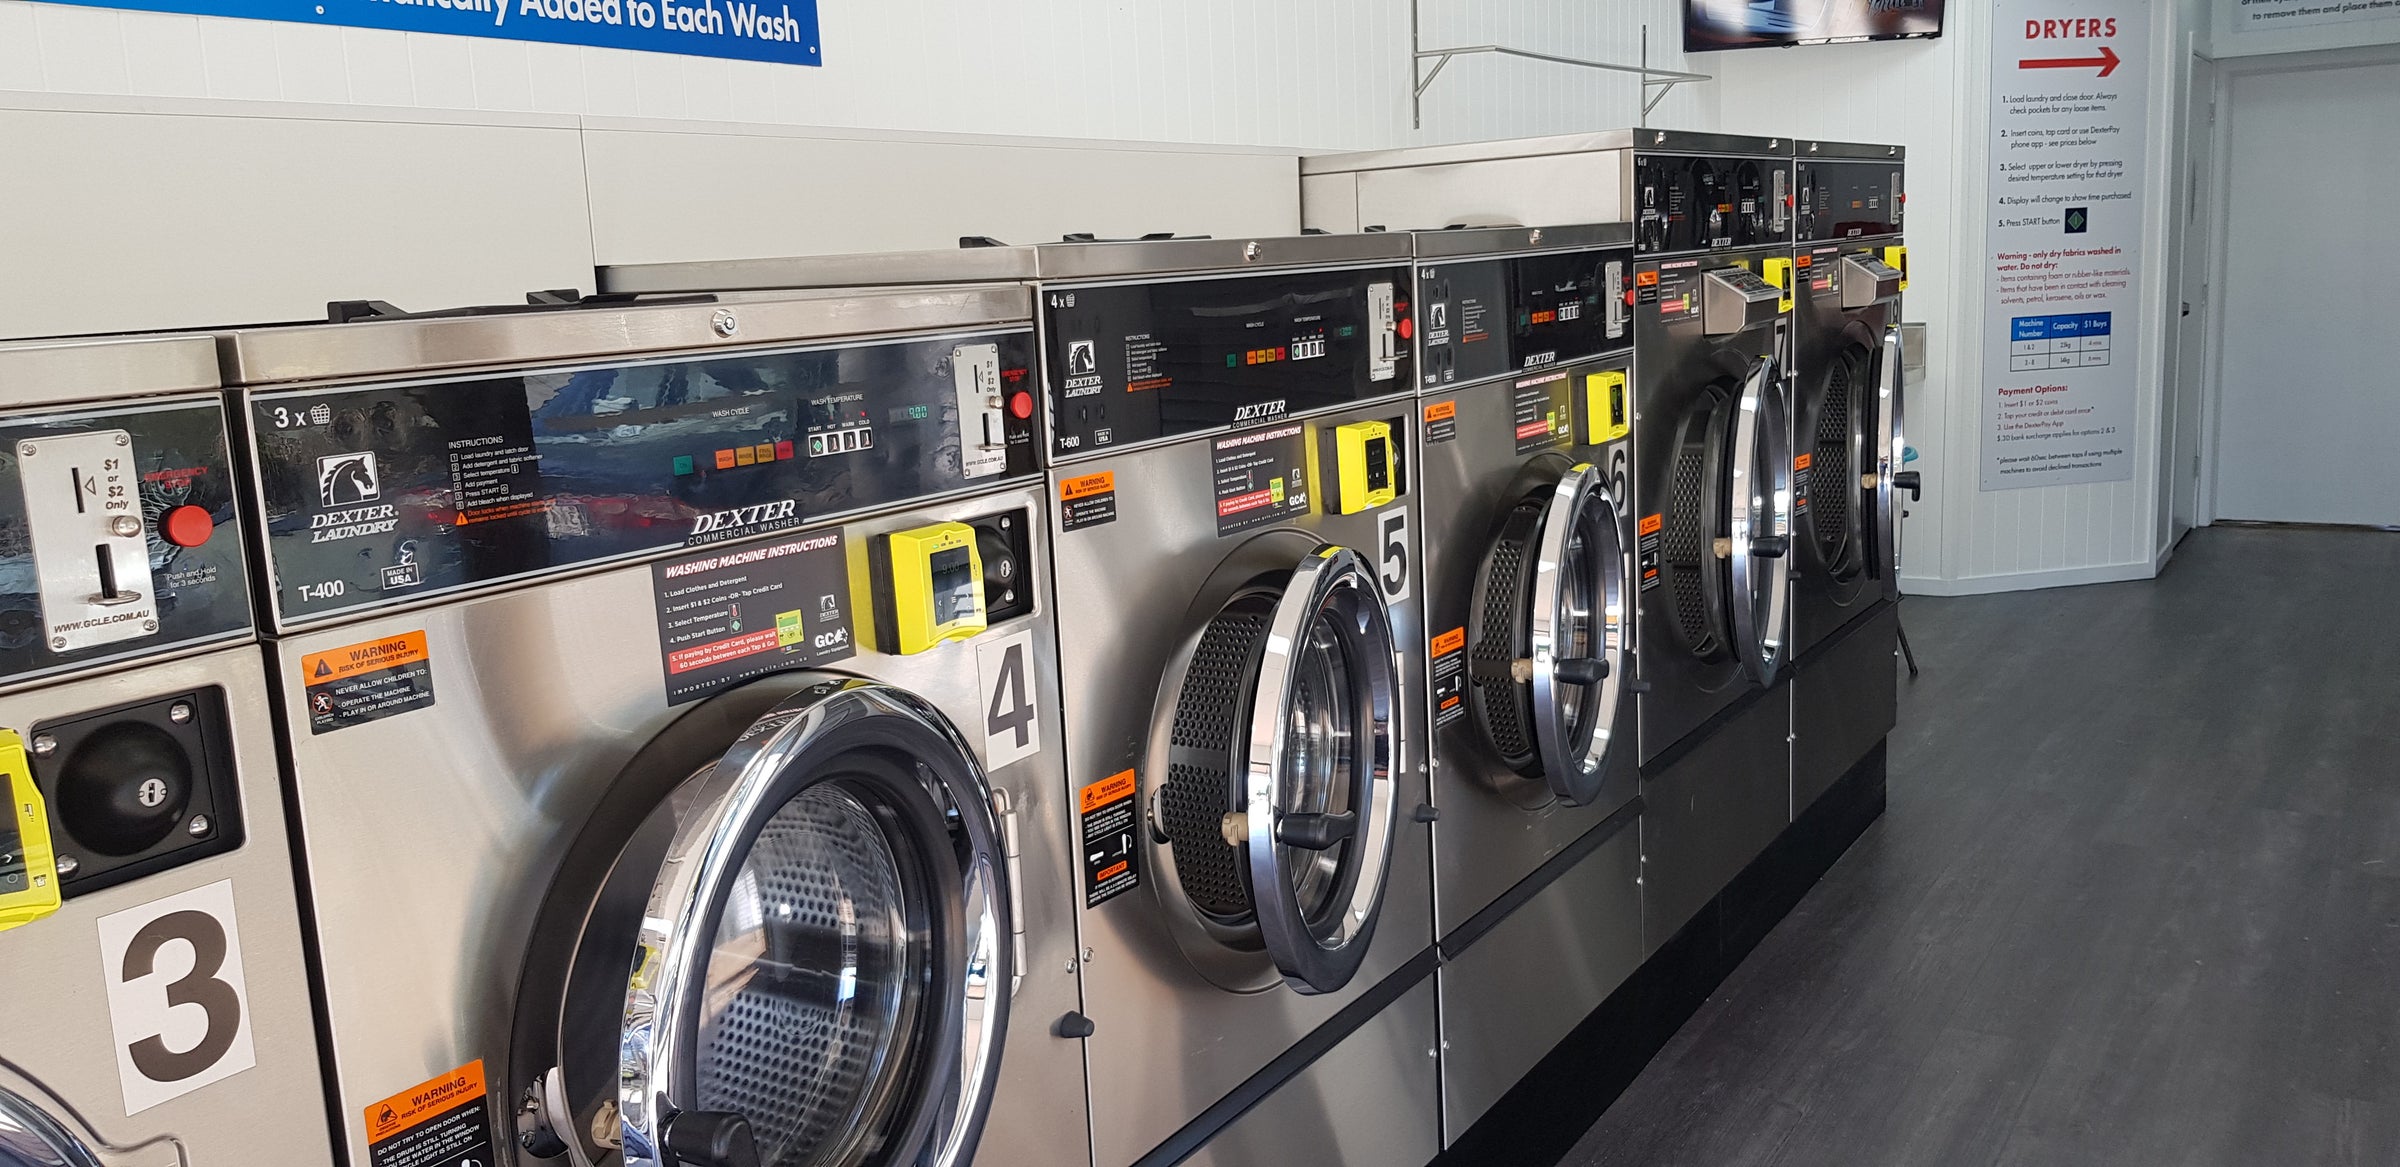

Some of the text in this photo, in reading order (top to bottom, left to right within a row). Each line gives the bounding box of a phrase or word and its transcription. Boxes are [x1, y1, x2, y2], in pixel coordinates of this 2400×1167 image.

[2263, 10, 2297, 20] remove
[2299, 7, 2321, 16] them
[2323, 5, 2340, 14] and
[2342, 3, 2367, 14] place
[2369, 1, 2393, 9] them
[626, 0, 655, 29] to
[663, 2, 724, 36] Each
[730, 11, 801, 43] Wash
[2025, 18, 2117, 40] DRYERS
[2010, 95, 2025, 103] Load
[2025, 95, 2048, 104] laundry
[2050, 94, 2062, 102] and
[2096, 92, 2117, 101] Always
[2045, 129, 2055, 137] tap
[2057, 127, 2070, 136] card
[2090, 126, 2120, 135] DexterPay
[2011, 140, 2030, 150] phone
[2031, 141, 2044, 149] app
[2060, 139, 2077, 148] prices
[2079, 138, 2097, 146] below
[2008, 163, 2026, 171] Select
[2029, 162, 2046, 172] upper
[2055, 161, 2072, 169] lower
[2073, 160, 2089, 169] dryer
[2090, 159, 2098, 169] by
[2099, 160, 2123, 168] pressing
[2008, 170, 2123, 182] desired temperature setting for that dryer
[1997, 252, 2028, 261] Warning
[2033, 251, 2048, 260] only
[2050, 250, 2062, 260] dry
[2063, 249, 2086, 257] fabrics
[2087, 247, 2114, 256] washed
[1997, 264, 2019, 272] water.
[2044, 261, 2058, 270] dry:
[1051, 294, 1065, 309] 4 x
[1776, 324, 1785, 368] 7
[1524, 352, 1555, 367] DEXTER
[1065, 375, 1101, 389] DEXTER
[1998, 385, 2069, 397] Payment Options:
[1065, 385, 1104, 398] LAUNDRY
[274, 406, 307, 429] 3 x
[1234, 400, 1286, 422] DEXTER
[1232, 412, 1289, 429] COMMERCIAL WASHER
[448, 436, 504, 449] INSTRUCTIONS
[1060, 436, 1080, 449] T-600
[104, 458, 120, 471] $1
[108, 474, 119, 483] or
[143, 466, 208, 482] EMERGENCY
[1080, 476, 1105, 488] WARNING
[1611, 449, 1626, 512] 6
[108, 485, 124, 499] $2
[164, 478, 192, 490] STOP
[105, 499, 129, 512] Only
[310, 504, 395, 529] DEXTER
[690, 499, 796, 536] DEXTER
[311, 519, 399, 544] LAUNDRY
[688, 517, 800, 546] COMMERCIAL WASHER
[666, 535, 838, 579] WASHING MACHINE INSTRUCTIONS
[1383, 515, 1407, 596] 5
[167, 566, 217, 581] Push and Hold
[386, 567, 414, 577] MADE IN
[390, 572, 412, 585] USA
[169, 581, 180, 589] for
[187, 575, 216, 586] seconds
[298, 580, 345, 602] T-400
[670, 589, 685, 597] Load
[685, 584, 707, 594] Clothes
[708, 581, 719, 589] and
[720, 576, 747, 587] Detergent
[673, 603, 690, 612] Insert
[703, 598, 711, 606] $2
[712, 595, 727, 603] Coins
[753, 586, 770, 595] Credit
[770, 583, 783, 591] Card
[53, 609, 150, 634] WWW.GCLE.COM.AU
[677, 634, 691, 643] Push
[692, 631, 706, 639] Start
[706, 626, 726, 635] Button
[349, 640, 407, 662] WARNING
[338, 663, 355, 673] RISK
[366, 655, 395, 667] SERIOUS
[396, 649, 420, 660] INJURY
[335, 684, 359, 696] NEVER
[359, 678, 383, 690] ALLOW
[383, 671, 416, 684] CHILDREN
[341, 686, 412, 708] OPERATE THE MACHINE
[343, 691, 430, 718] PLAY IN OR AROUND MACHINE
[987, 642, 1035, 749] 4
[122, 909, 242, 1083] 3
[411, 1076, 466, 1107] WARNING
[401, 1082, 478, 1120] RISK OF SERIOUS INJURY
[377, 1148, 387, 1156] DO
[388, 1141, 401, 1152] NOT
[402, 1134, 415, 1145] TRY
[425, 1123, 442, 1135] OPEN
[443, 1114, 461, 1127] DOOR
[461, 1106, 481, 1118] WHEN:
